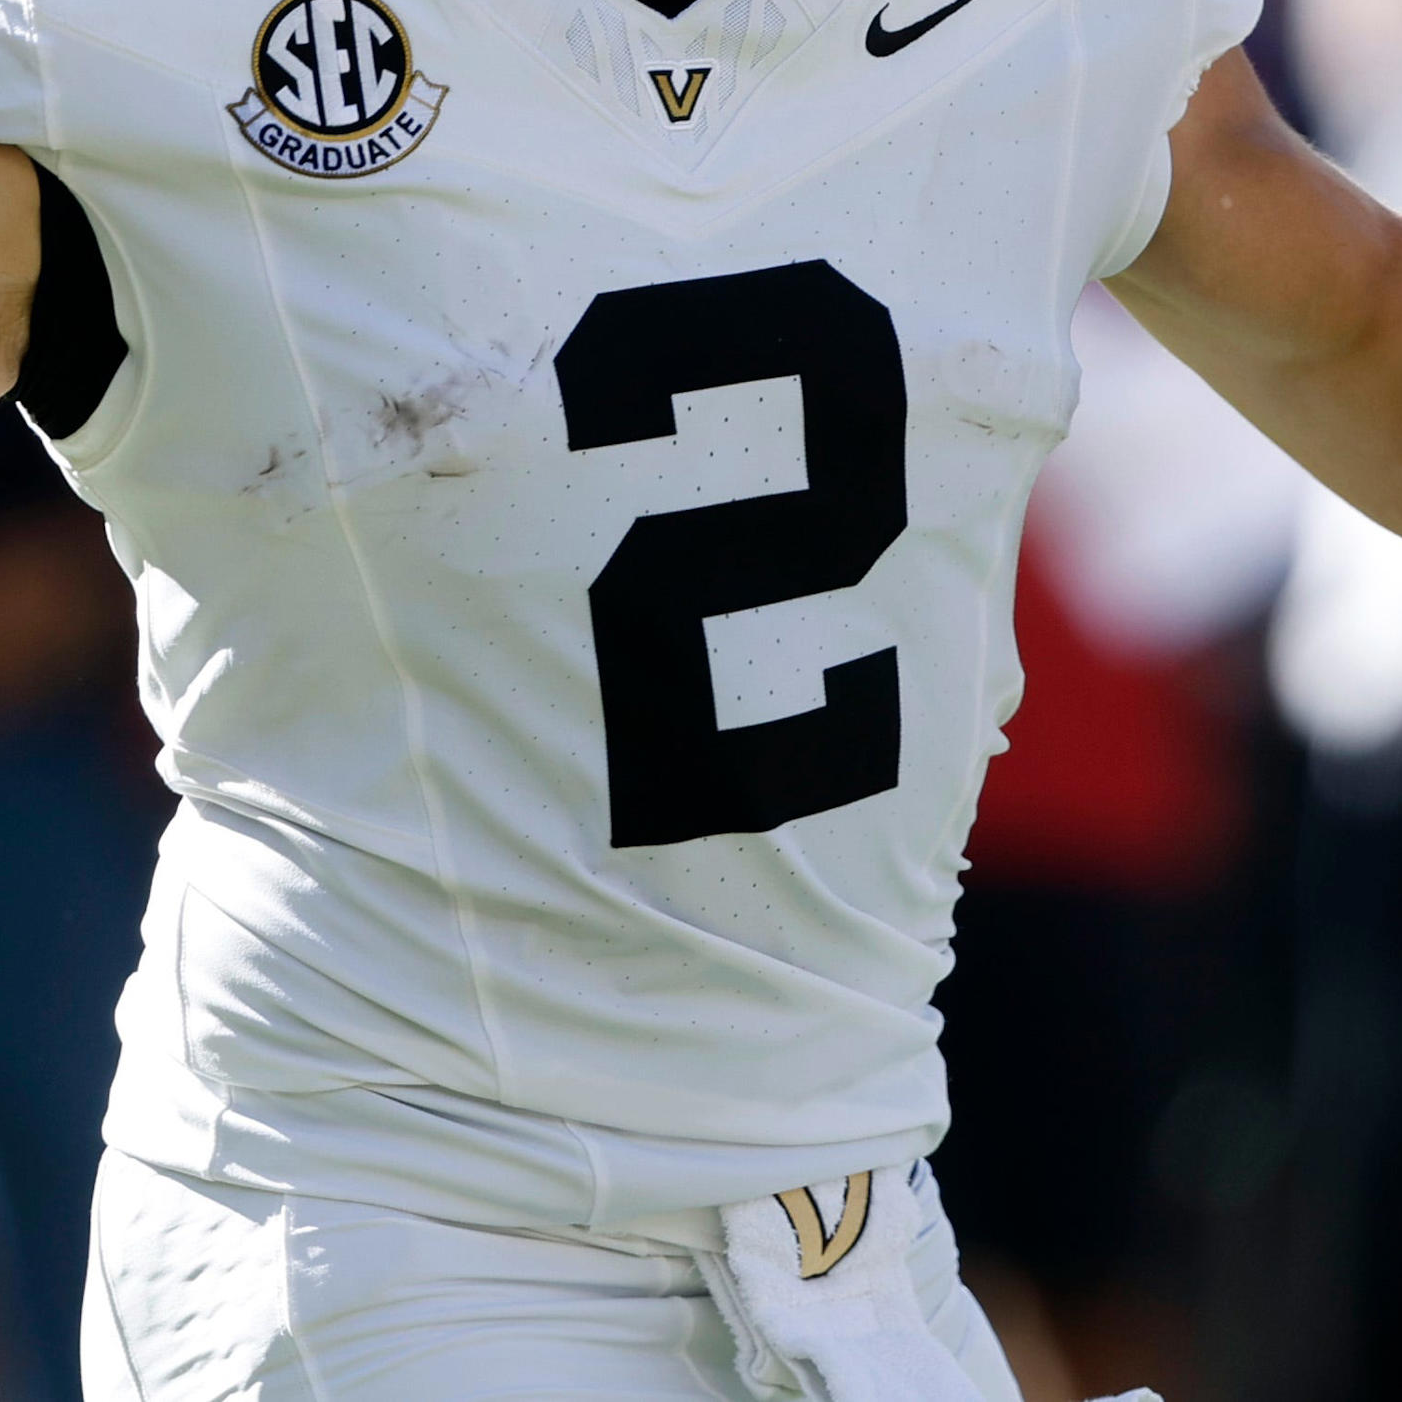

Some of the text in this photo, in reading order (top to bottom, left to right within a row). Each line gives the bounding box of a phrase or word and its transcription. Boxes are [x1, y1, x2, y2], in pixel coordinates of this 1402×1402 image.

[648, 66, 712, 124] V
[258, 110, 424, 172] GRADUATE
[553, 258, 908, 849] 2
